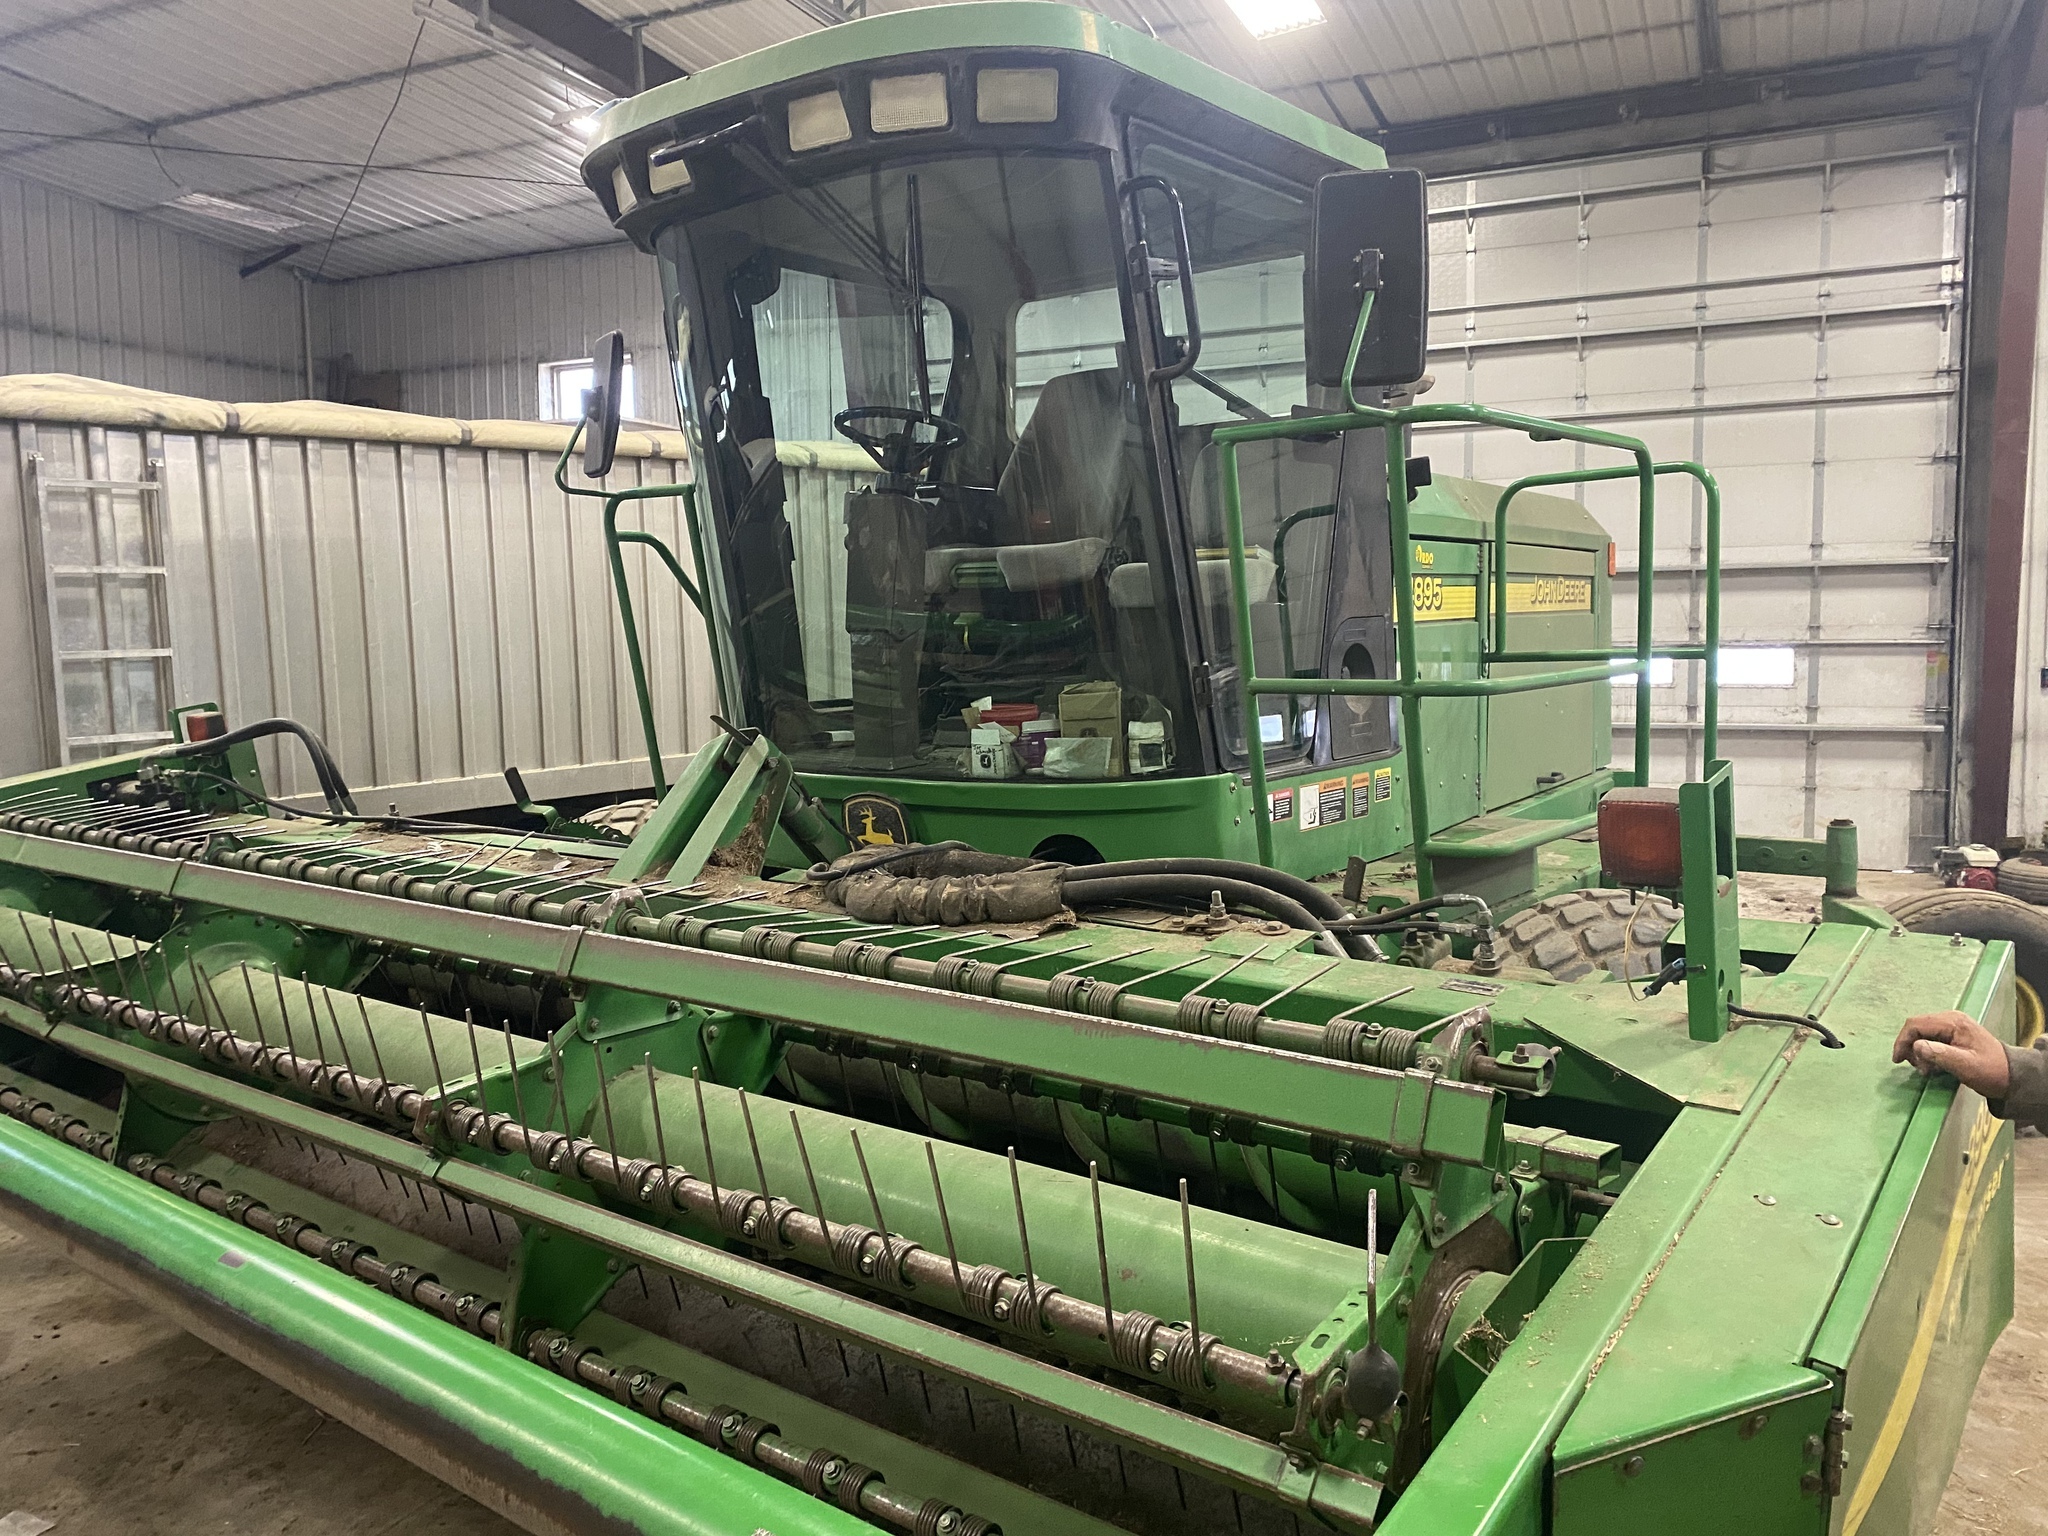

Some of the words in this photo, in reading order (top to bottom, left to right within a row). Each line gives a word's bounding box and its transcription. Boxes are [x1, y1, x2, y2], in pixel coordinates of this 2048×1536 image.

[1411, 576, 1443, 611] 895
[1531, 575, 1557, 604] JOHN
[1557, 576, 1586, 603] DEERE
